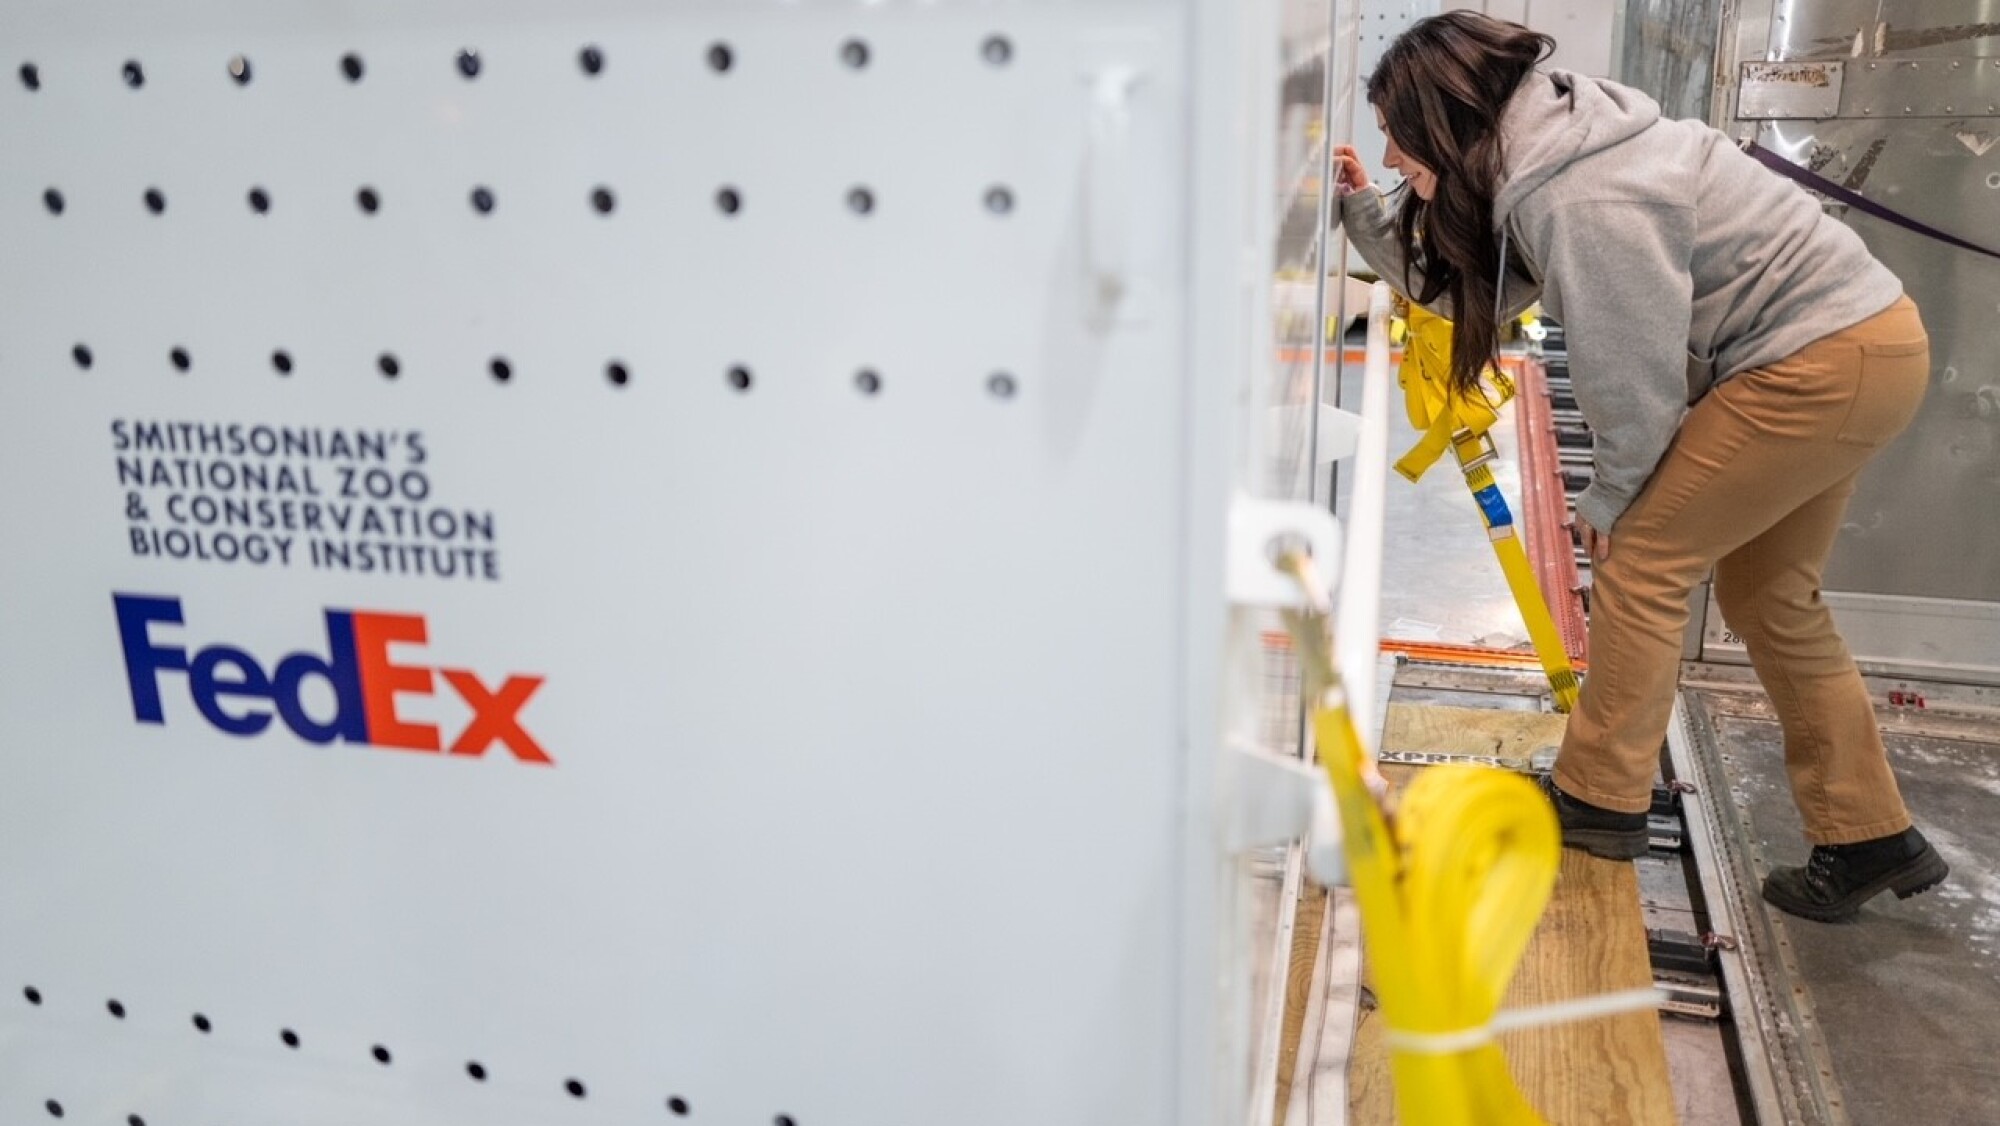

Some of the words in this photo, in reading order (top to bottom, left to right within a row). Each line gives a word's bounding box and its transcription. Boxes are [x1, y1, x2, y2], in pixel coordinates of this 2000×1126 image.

[116, 455, 321, 497] NATIONAL
[336, 466, 431, 503] ZOO
[124, 491, 149, 522] &
[166, 493, 496, 543] CONSERVATION
[128, 525, 293, 566] BIOLOGY
[309, 538, 500, 580] INSTITUTE
[111, 591, 555, 767] FedEx
